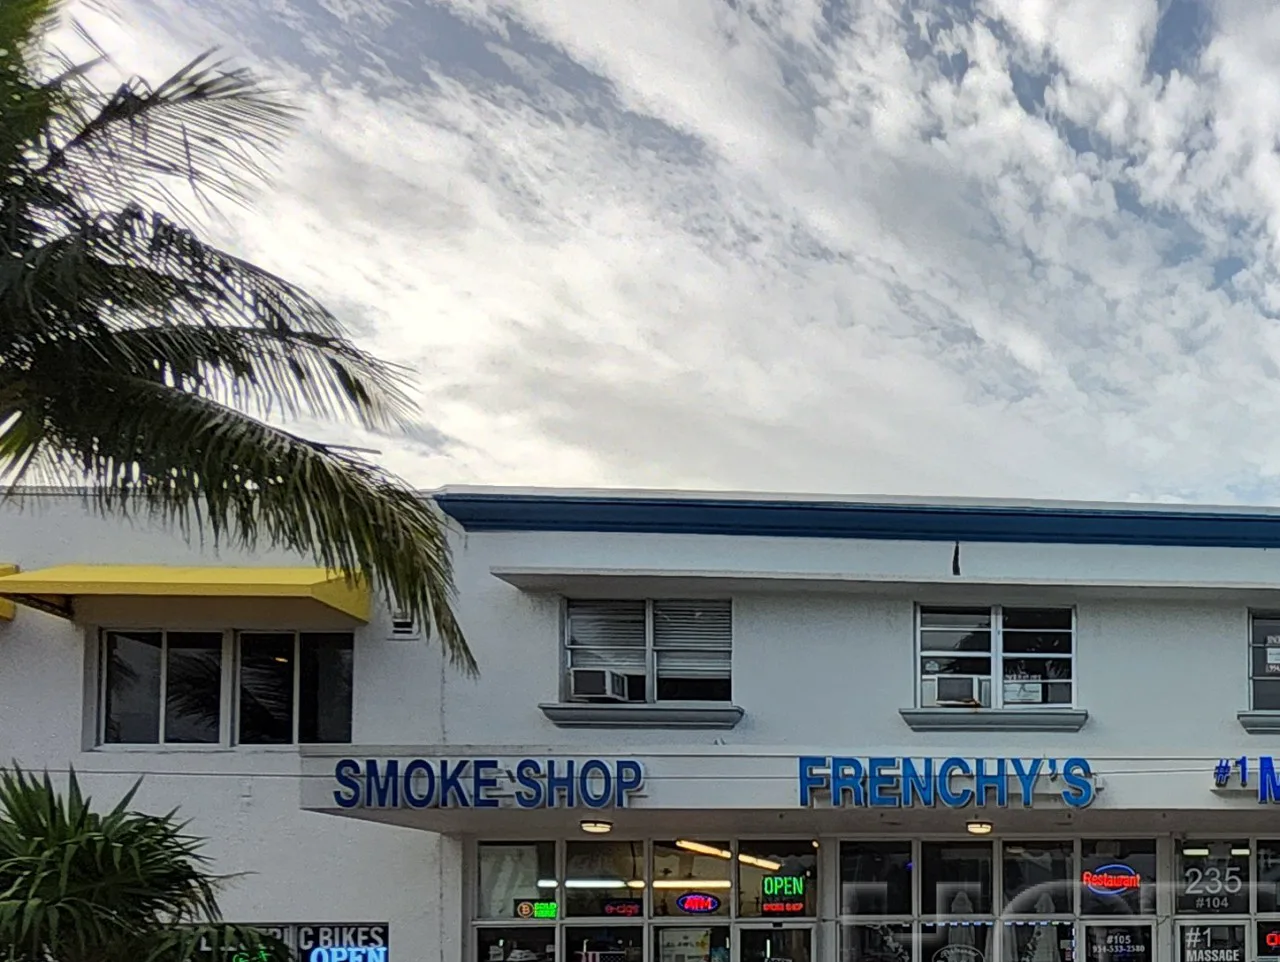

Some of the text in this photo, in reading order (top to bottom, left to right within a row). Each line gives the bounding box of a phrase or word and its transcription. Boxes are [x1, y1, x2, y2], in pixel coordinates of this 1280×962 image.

[799, 756, 1094, 808] FRENCHY'S
[1214, 756, 1248, 787] #1
[333, 759, 643, 808] SMOKE SHOP
[764, 876, 803, 895] OPEN
[1082, 871, 1141, 888] Restaurant
[1185, 867, 1242, 895] 235
[1196, 897, 1229, 909] #104
[319, 926, 384, 949] BIKES
[1185, 927, 1212, 949] #1
[1186, 949, 1240, 962] MASSAGE
